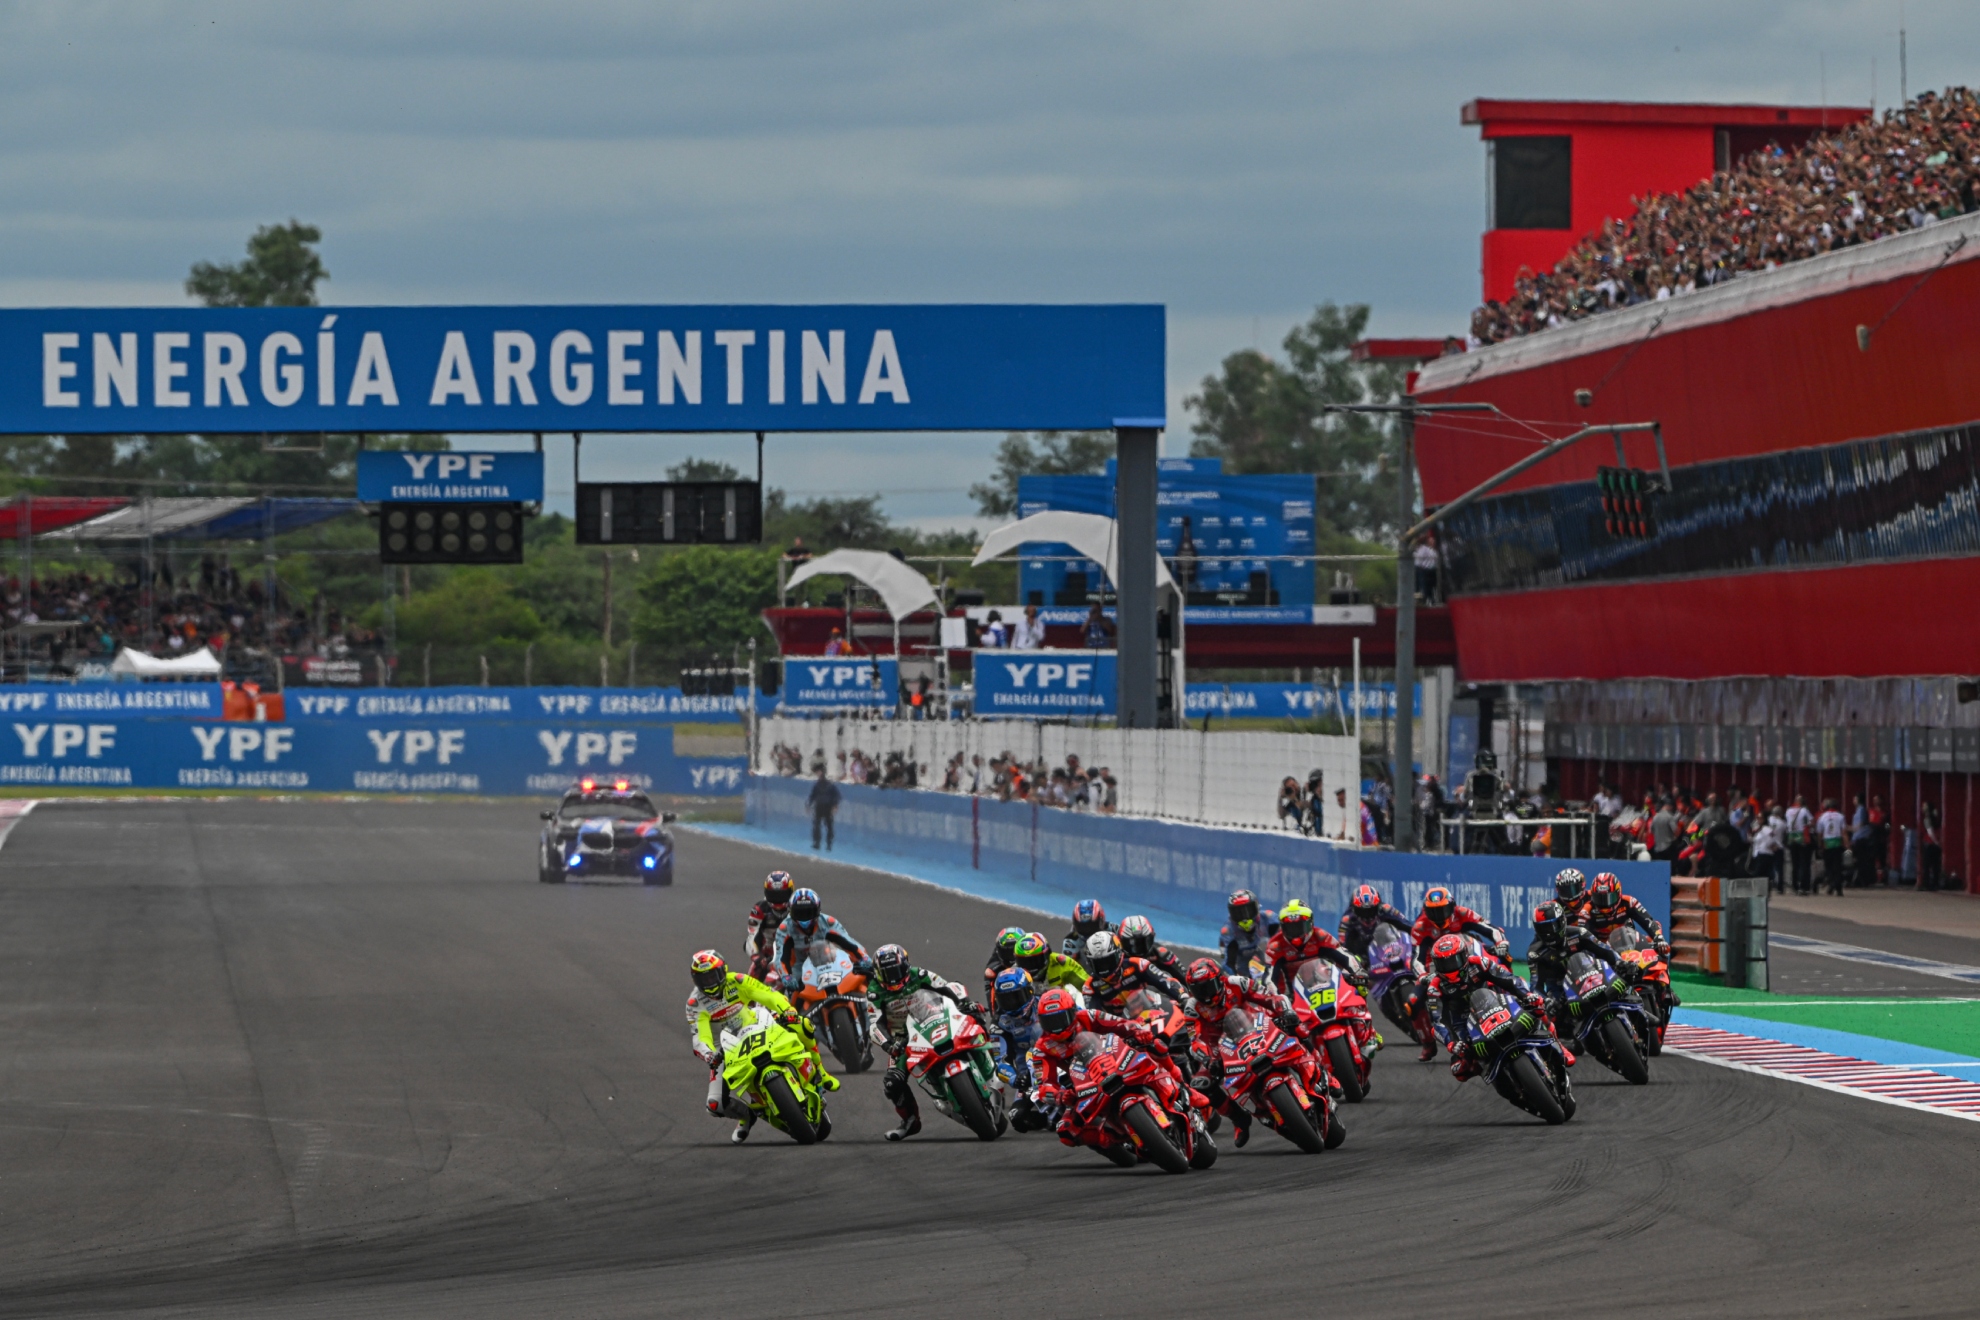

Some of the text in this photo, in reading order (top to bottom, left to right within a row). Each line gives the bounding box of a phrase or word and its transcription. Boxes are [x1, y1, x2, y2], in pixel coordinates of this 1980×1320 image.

[42, 314, 911, 408] ENERGÍA ARGENTINA
[403, 454, 495, 479] YPF
[391, 483, 510, 498] ENERGÍA ARGENTINA
[808, 665, 875, 687] YPF
[1005, 663, 1092, 688] YPF
[0, 688, 210, 711] YPF ENERGÍA ARGENTINA
[298, 696, 349, 715] YPF
[539, 695, 592, 714] YPF
[13, 723, 117, 758] YPF
[192, 726, 295, 762] YPF
[367, 728, 466, 765] YPF
[538, 729, 638, 766] YPF
[1, 763, 132, 785] ENERGÍA ARGENTINA
[690, 765, 742, 789] YPF
[1501, 884, 1525, 928] YPF
[817, 970, 842, 991] 25
[1309, 988, 1336, 1011] 36
[1480, 1008, 1511, 1036] 20
[1482, 1005, 1504, 1020] ENEOS
[738, 1031, 766, 1058] 49
[1237, 1034, 1267, 1062] 63
[1269, 1033, 1285, 1053] Lenovo
[1089, 1053, 1117, 1084] 93
[1119, 1049, 1135, 1071] Lenovo
[1077, 1086, 1098, 1098] Lenovo
